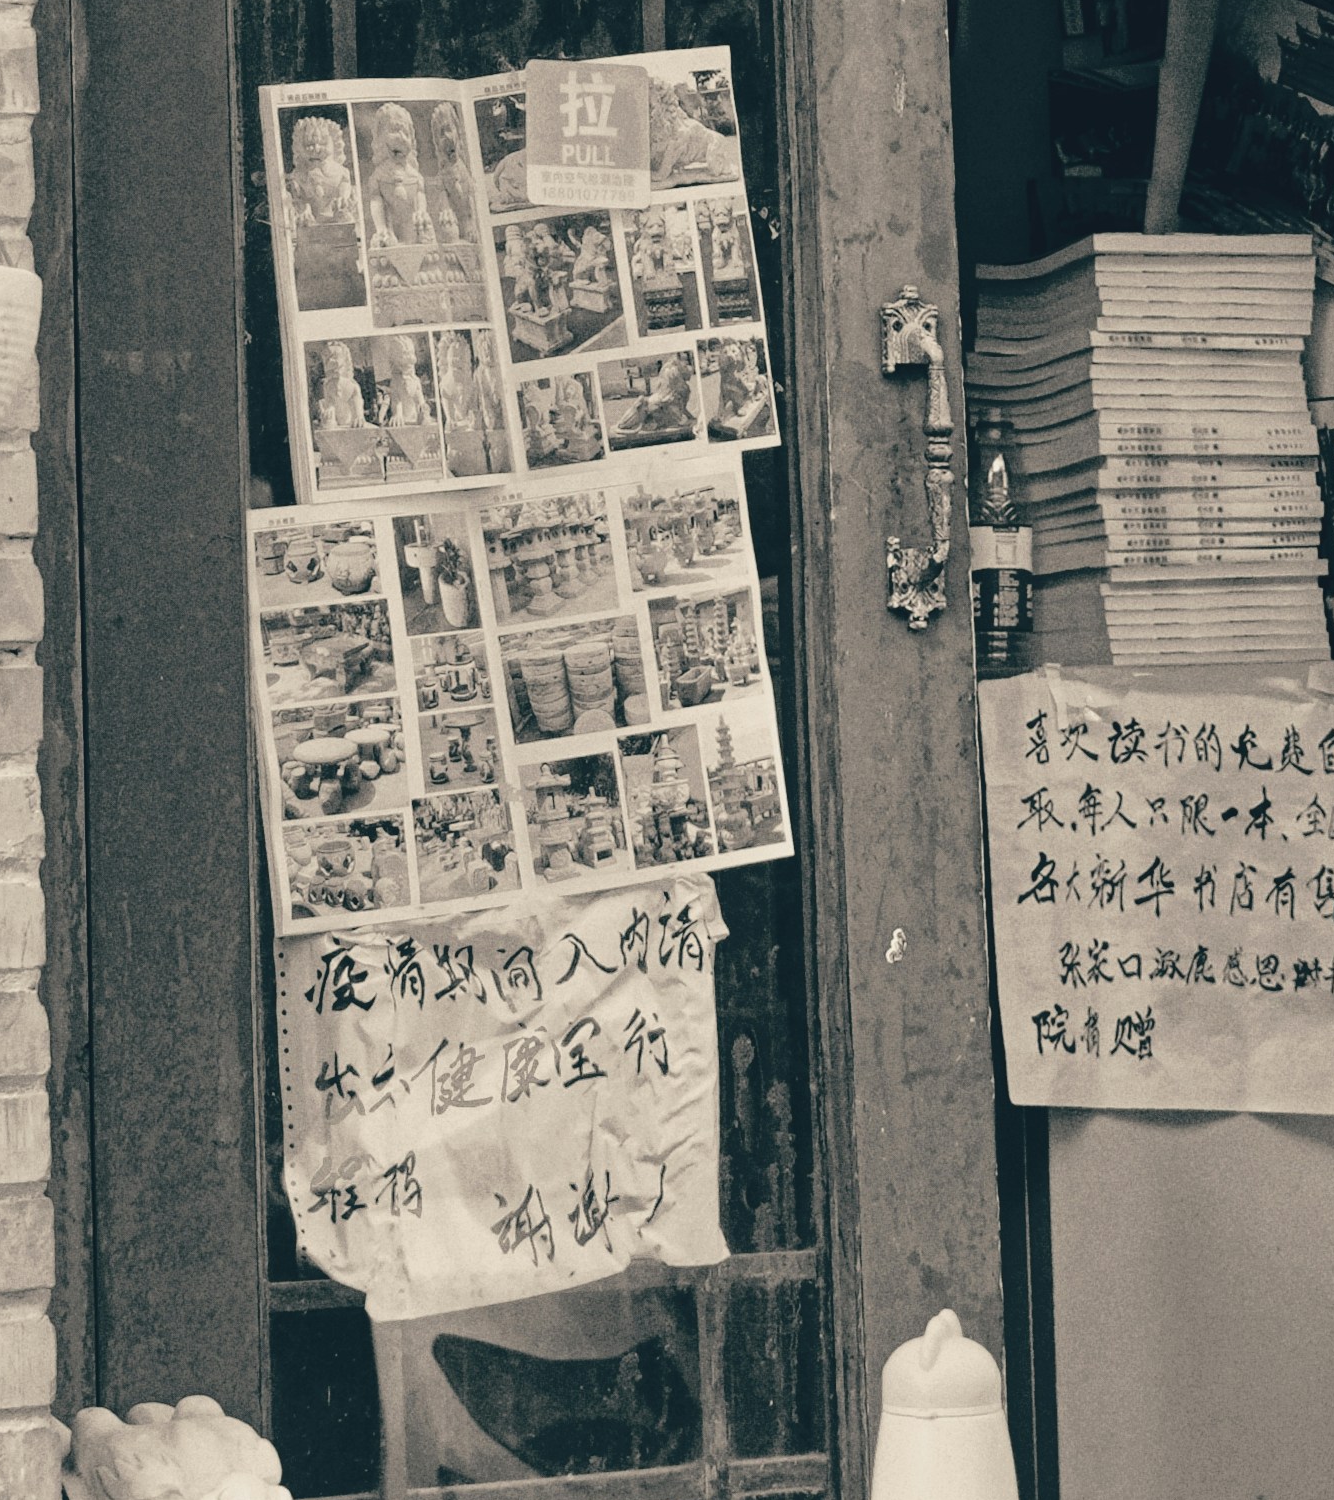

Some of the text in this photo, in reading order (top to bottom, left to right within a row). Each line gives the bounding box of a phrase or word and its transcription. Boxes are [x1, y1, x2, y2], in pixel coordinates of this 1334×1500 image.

[559, 70, 620, 139] 拉
[561, 143, 617, 168] PULL
[304, 890, 705, 1016] 疫情期间入内请
[315, 1007, 671, 1127] 出示健康宝行
